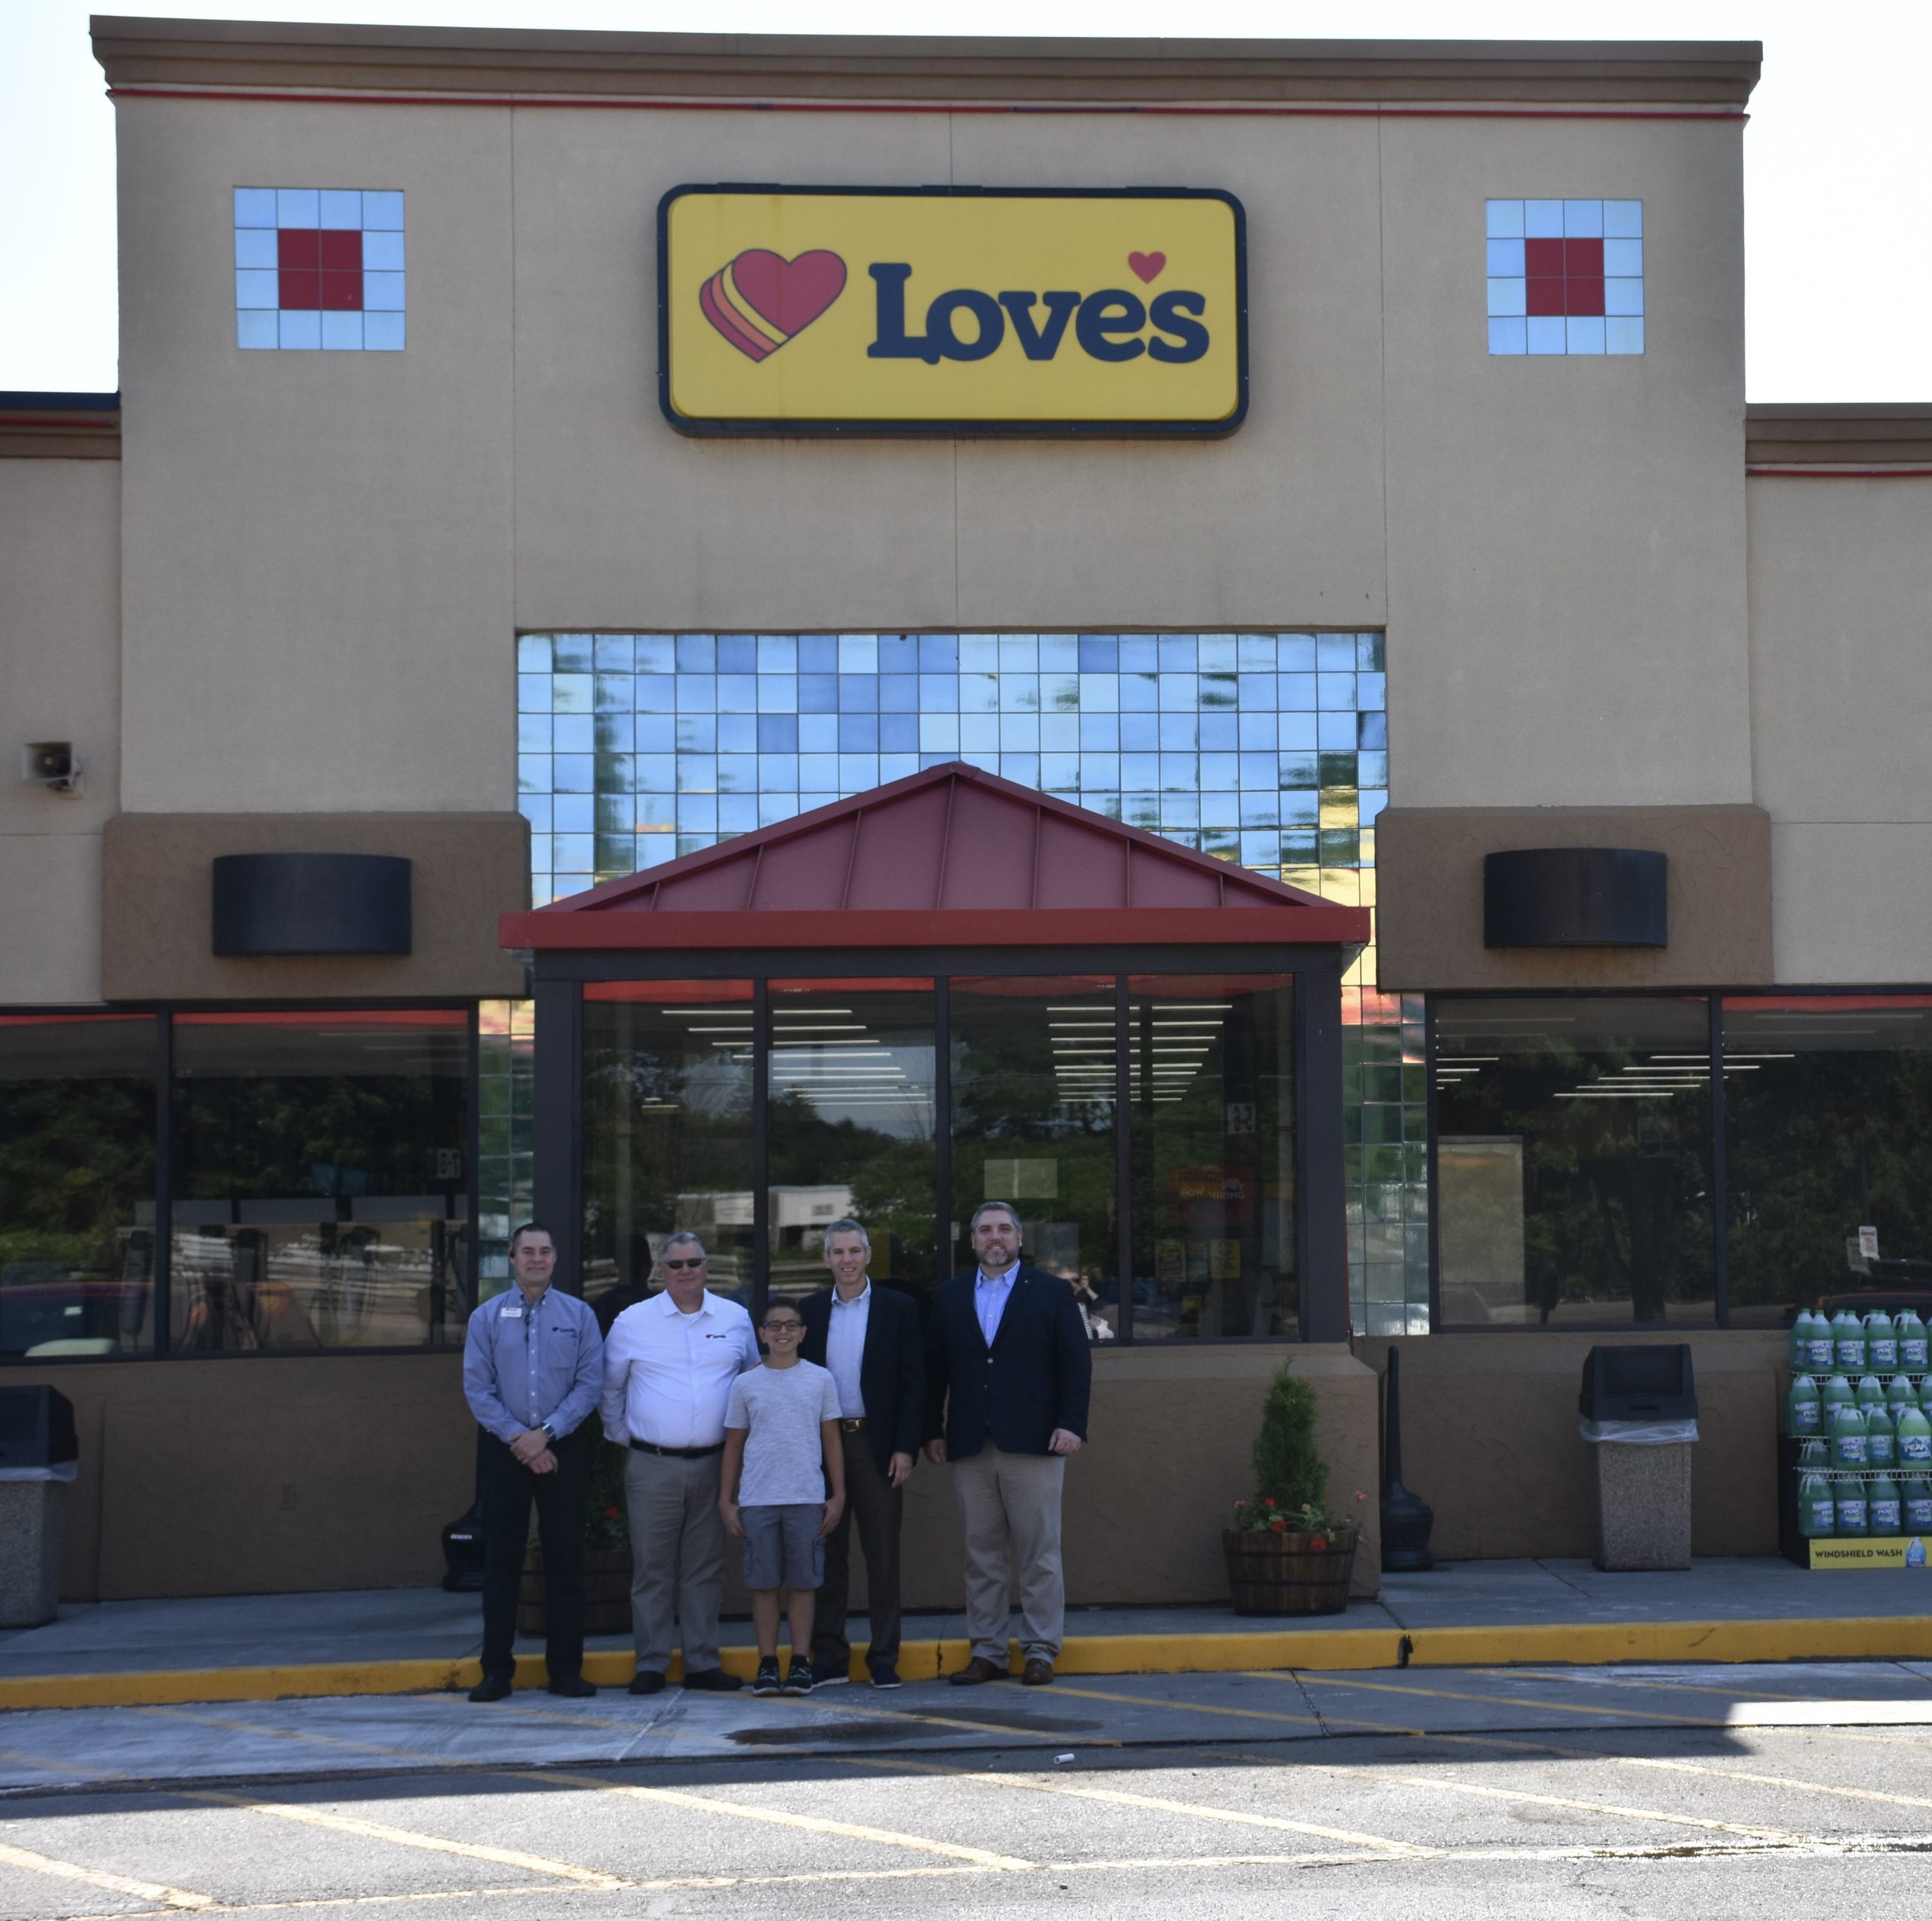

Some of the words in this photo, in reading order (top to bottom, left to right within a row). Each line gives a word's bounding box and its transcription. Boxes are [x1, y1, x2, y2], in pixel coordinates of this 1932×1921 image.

[1180, 1187, 1204, 1196] NOW
[1904, 1443, 1925, 1452] PEAK
[1815, 1550, 1873, 1558] WINDSHIELD
